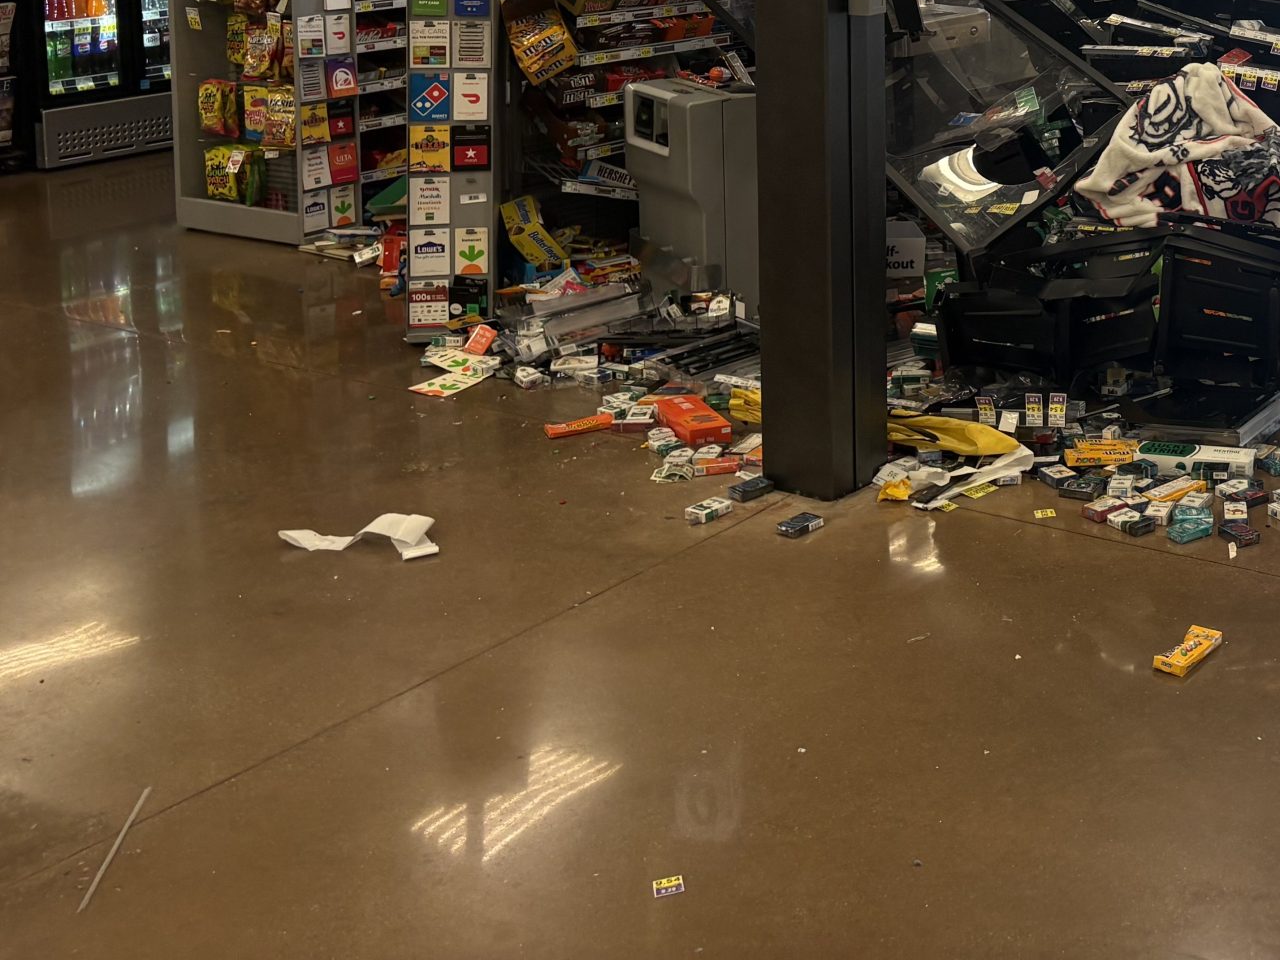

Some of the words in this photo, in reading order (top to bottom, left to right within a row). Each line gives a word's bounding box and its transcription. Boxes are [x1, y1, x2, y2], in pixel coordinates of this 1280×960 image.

[336, 154, 352, 163] ULTA
[207, 169, 228, 177] SOUR
[208, 176, 229, 184] PATCH
[417, 245, 443, 254] LOWE'S
[886, 245, 899, 256] lf-
[886, 258, 915, 269] kout
[412, 293, 431, 301] 100s
